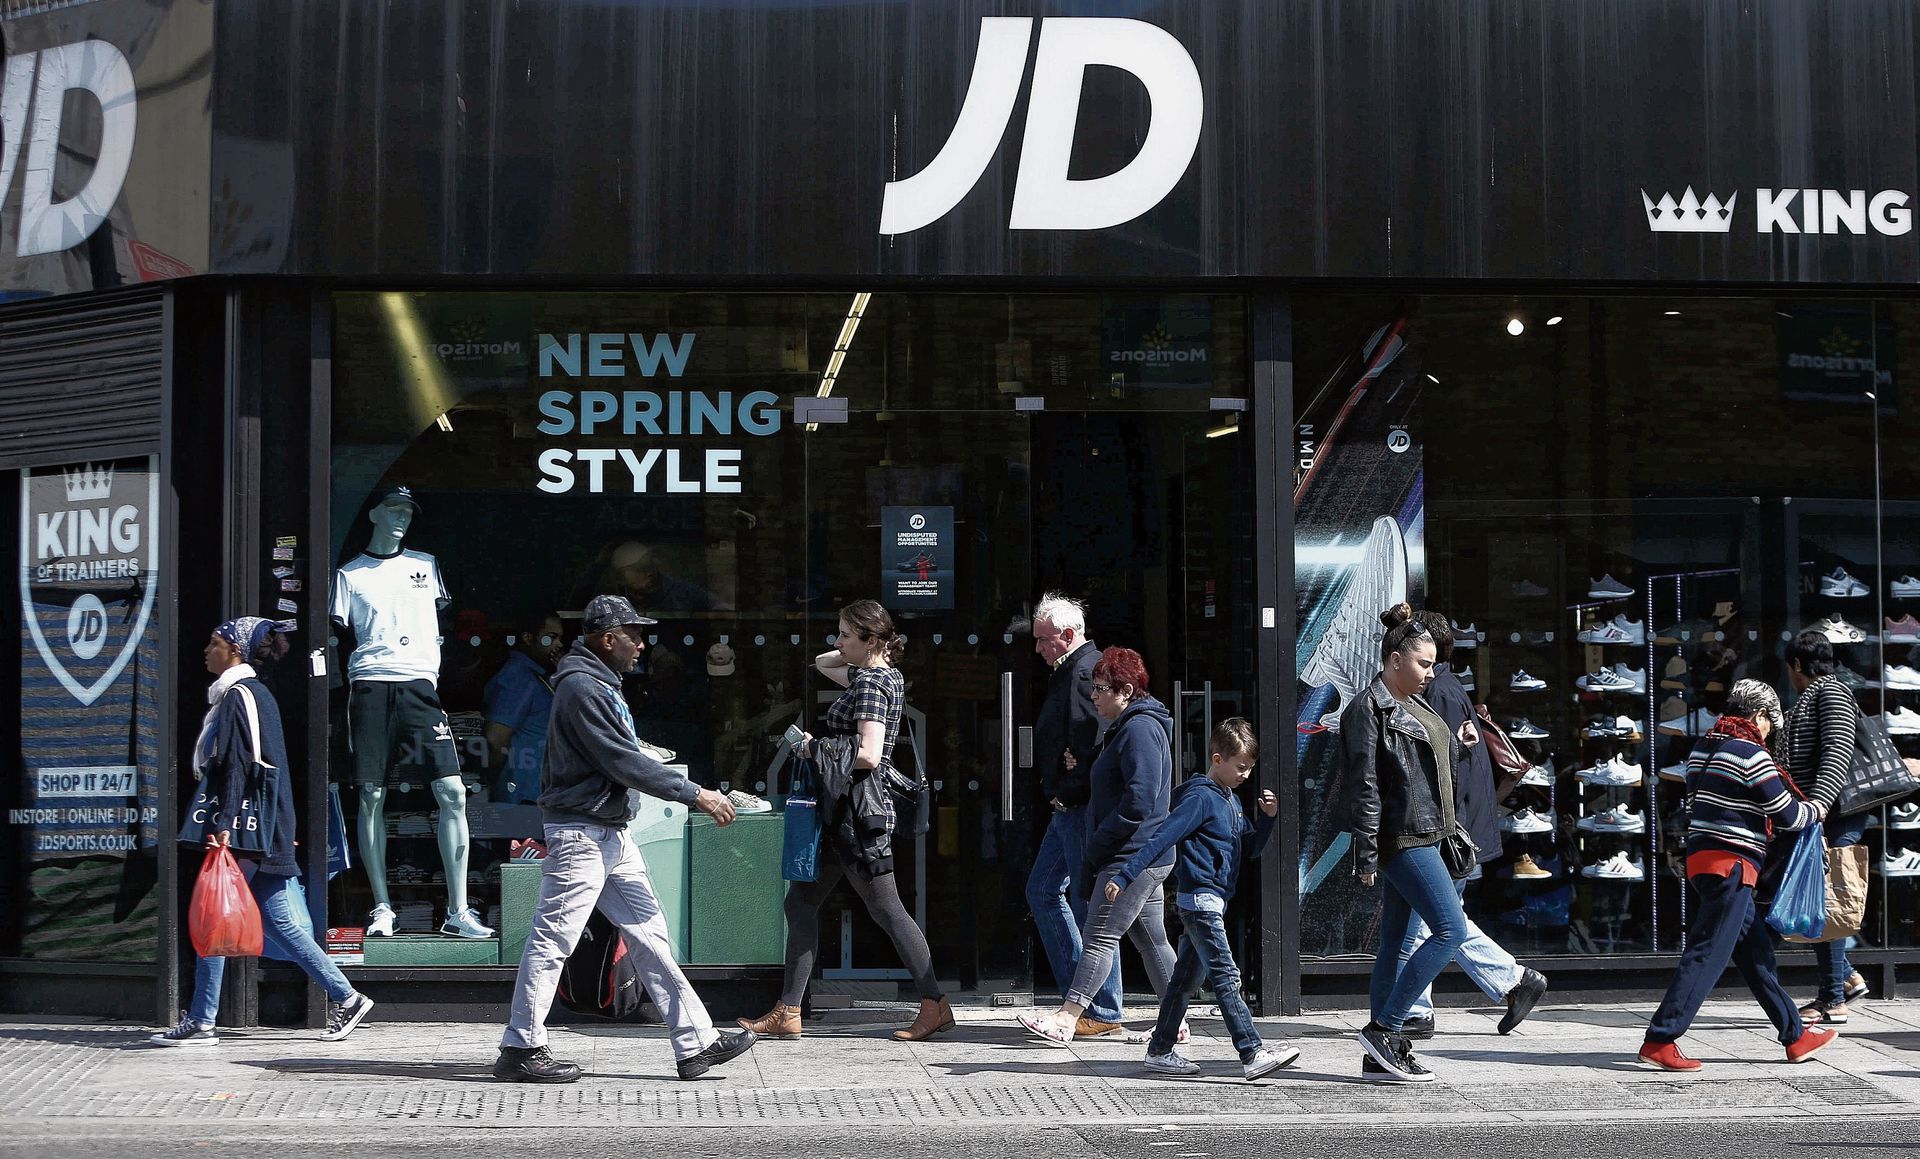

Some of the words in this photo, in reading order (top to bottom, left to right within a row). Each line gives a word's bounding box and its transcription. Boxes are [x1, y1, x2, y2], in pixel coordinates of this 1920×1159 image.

[879, 16, 1204, 234] JD
[1756, 188, 1912, 236] KING
[538, 333, 696, 377] NEW
[536, 390, 782, 436] SPRING
[1390, 435, 1408, 447] JD
[536, 448, 742, 493] STYLE
[38, 504, 140, 560] KING
[911, 517, 923, 526] JD
[37, 565, 54, 583] OF
[57, 558, 140, 582] TRAINERS
[71, 610, 102, 644] JD
[41, 772, 81, 793] SHOP
[83, 772, 97, 792] IT
[100, 771, 134, 792] 24/7
[9, 809, 59, 824] INSTORE
[68, 808, 115, 823] ONLINE
[123, 808, 138, 823] JD
[38, 834, 138, 851] JDSPORTS.CO.UK
